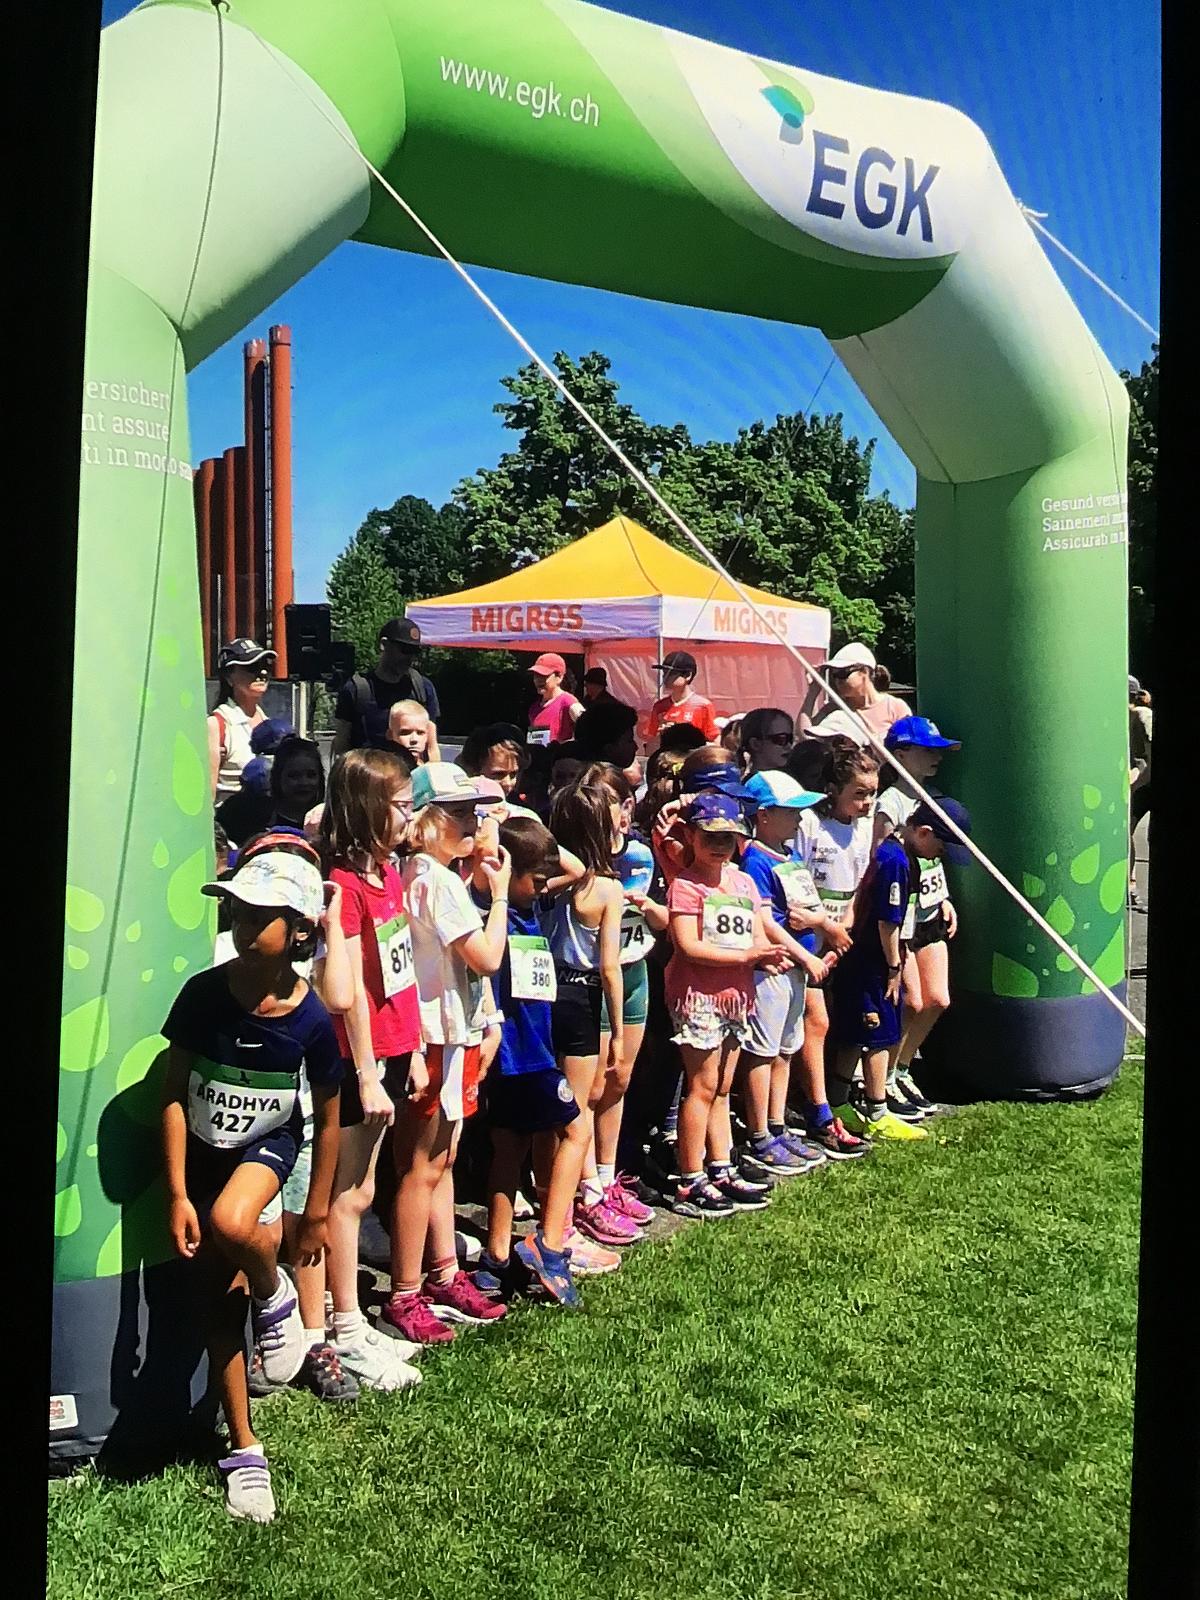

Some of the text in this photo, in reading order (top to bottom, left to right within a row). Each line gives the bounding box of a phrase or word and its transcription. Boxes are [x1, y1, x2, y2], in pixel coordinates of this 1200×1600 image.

[439, 55, 601, 128] www.egk.ch
[805, 129, 941, 243] EGK
[108, 442, 129, 468] in
[1041, 493, 1094, 513] Gesund
[471, 603, 585, 633] MIGROS
[713, 605, 788, 636] MIGROS
[532, 956, 550, 969] SAM
[531, 971, 551, 988] 380
[557, 969, 600, 987] NIKE
[196, 1082, 282, 1112] ARADHYA
[210, 1110, 256, 1134] 427
